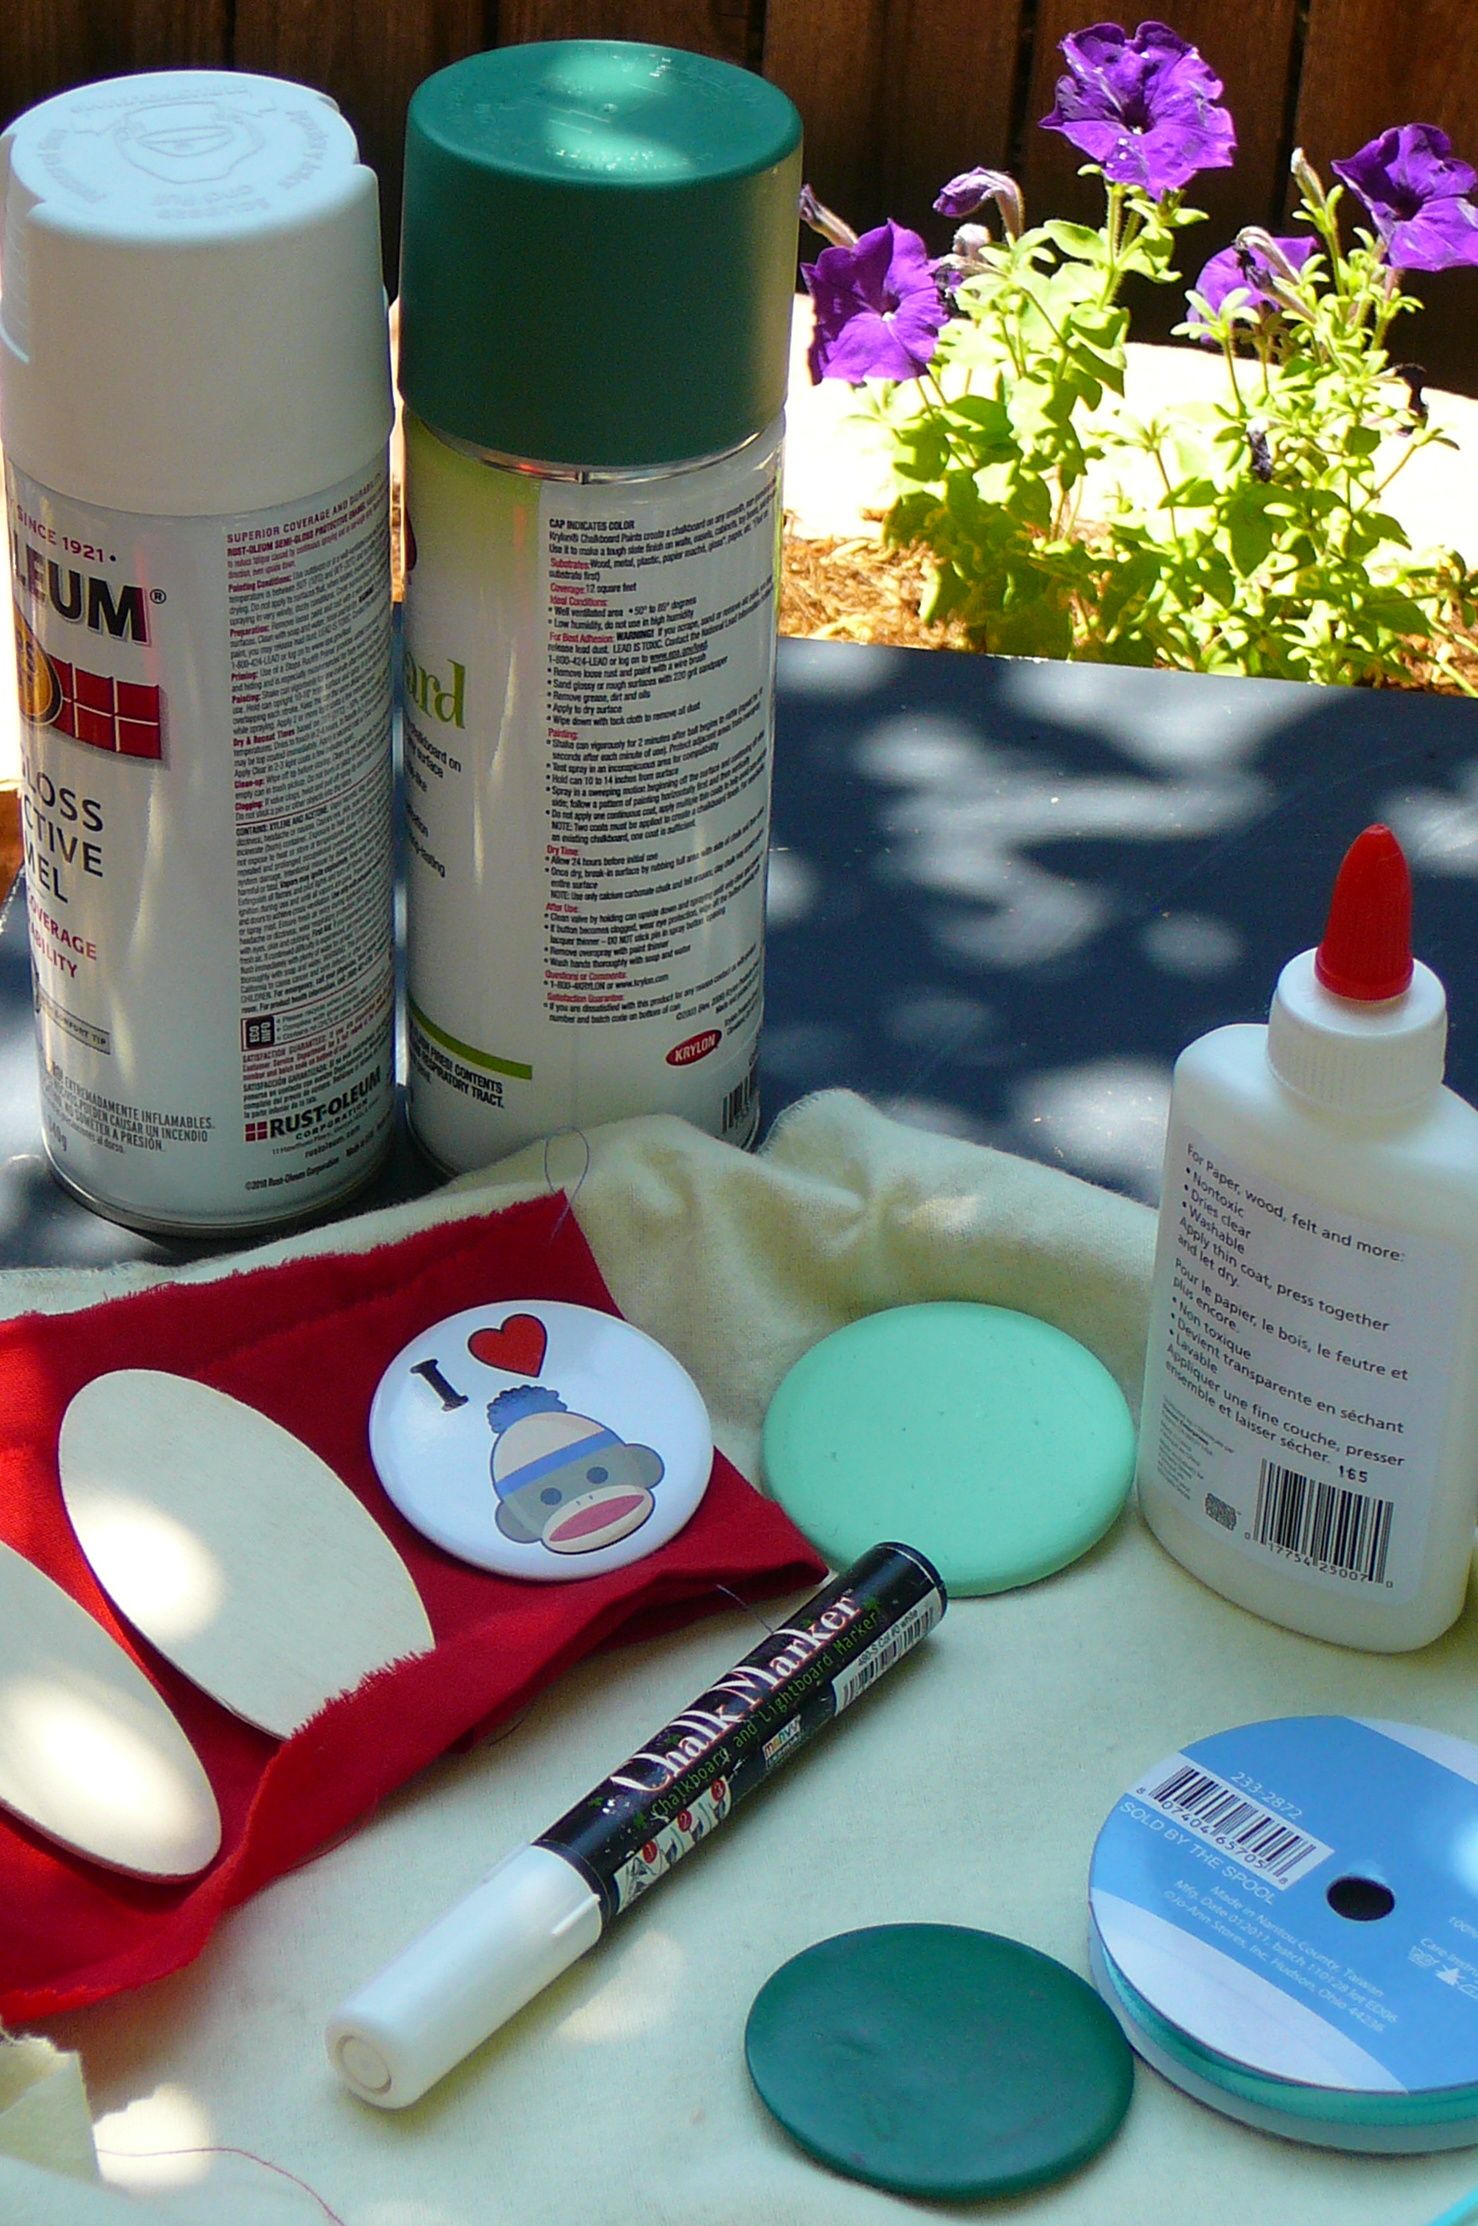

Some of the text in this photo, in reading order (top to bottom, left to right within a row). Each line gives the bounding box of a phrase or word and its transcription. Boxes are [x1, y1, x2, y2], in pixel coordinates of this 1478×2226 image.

[17, 504, 104, 562] SINCE 1921
[227, 526, 280, 543] SUPERIOR
[283, 508, 330, 534] COVERAGE
[332, 501, 348, 516] AND
[549, 518, 565, 529] CAP
[449, 757, 462, 774] on
[674, 1033, 716, 1063] KRYLON
[454, 1064, 503, 1094] CONTENTS
[471, 1085, 504, 1109] TRACT.
[110, 1115, 143, 1134] CAUSAR
[145, 1125, 159, 1138] UN
[161, 1127, 208, 1143] INCENDIO
[1187, 1143, 1204, 1165] For
[1245, 1189, 1287, 1222] wood,
[1291, 1213, 1318, 1235] felt
[1321, 1228, 1352, 1247] and
[1190, 1188, 1252, 1240] Dries clear
[1193, 1171, 1245, 1219] Nontoxic
[1178, 1234, 1198, 1257] and
[1199, 1250, 1215, 1271] let
[1189, 1204, 1246, 1255] Washable
[1172, 1276, 1194, 1301] plus
[1179, 1216, 1391, 1332] Apply thin coat, press together
[1174, 1257, 1409, 1381] Pour le papier, le bois, le feutre et
[1179, 1301, 1252, 1361] Non toxique
[1176, 1333, 1218, 1375] Lavable
[1177, 1316, 1405, 1434] Devient transparente en séchant
[409, 1358, 469, 1412] I
[1165, 1360, 1217, 1407] ensemble
[1218, 1403, 1232, 1419] et
[1235, 1411, 1277, 1442] laisser
[1166, 1343, 1406, 1467] Appliquer une fine couche, presser
[1267, 1542, 1311, 1567] 17754
[1318, 1562, 1369, 1583] 25007
[651, 1750, 731, 1818] Chalkboard
[733, 1720, 759, 1748] and
[757, 1654, 833, 1723] Lightboard
[832, 1611, 878, 1656] Marker
[609, 1708, 748, 1792] Chalk
[1231, 1771, 1303, 1820] 233-2872
[1119, 1801, 1279, 1906] SOLD BY THE SPOOL
[1161, 1800, 1210, 1835] 07404
[1215, 1835, 1266, 1871] 65705
[1210, 1885, 1244, 1911] Made
